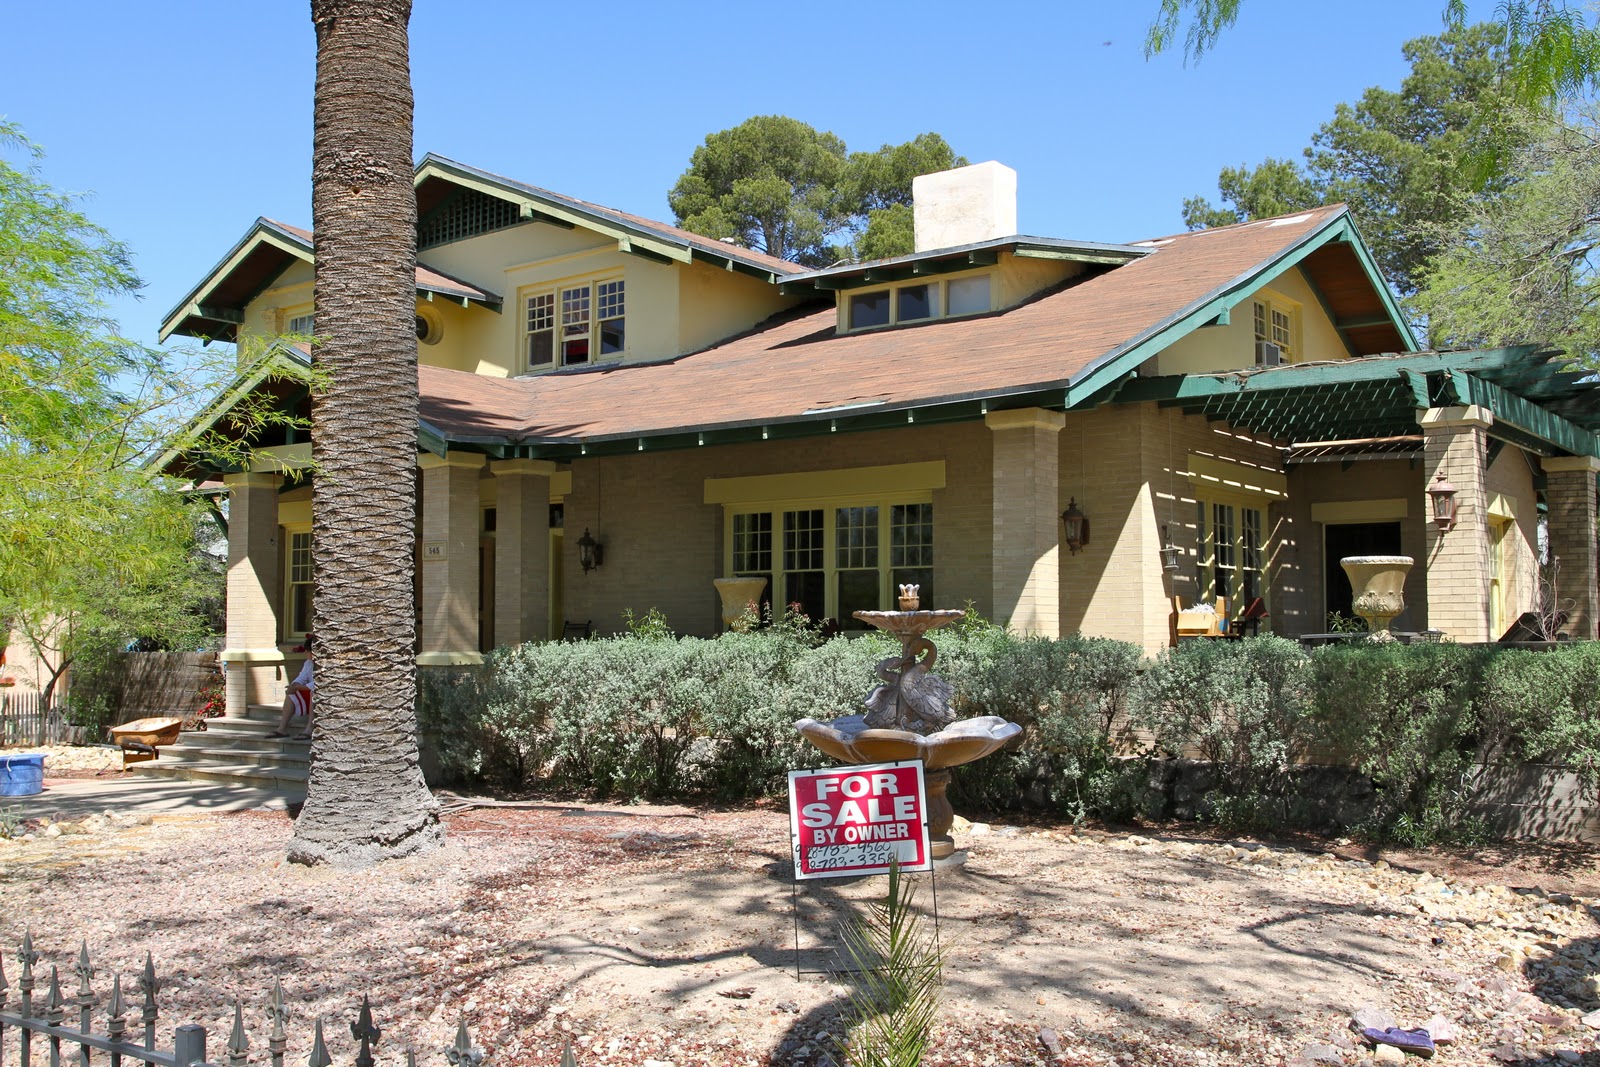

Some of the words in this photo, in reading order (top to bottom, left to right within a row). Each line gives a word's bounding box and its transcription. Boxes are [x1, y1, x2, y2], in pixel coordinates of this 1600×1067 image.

[816, 773, 898, 800] FOR
[802, 796, 917, 828] SALE
[814, 828, 838, 844] BY
[844, 823, 909, 842] OWNER
